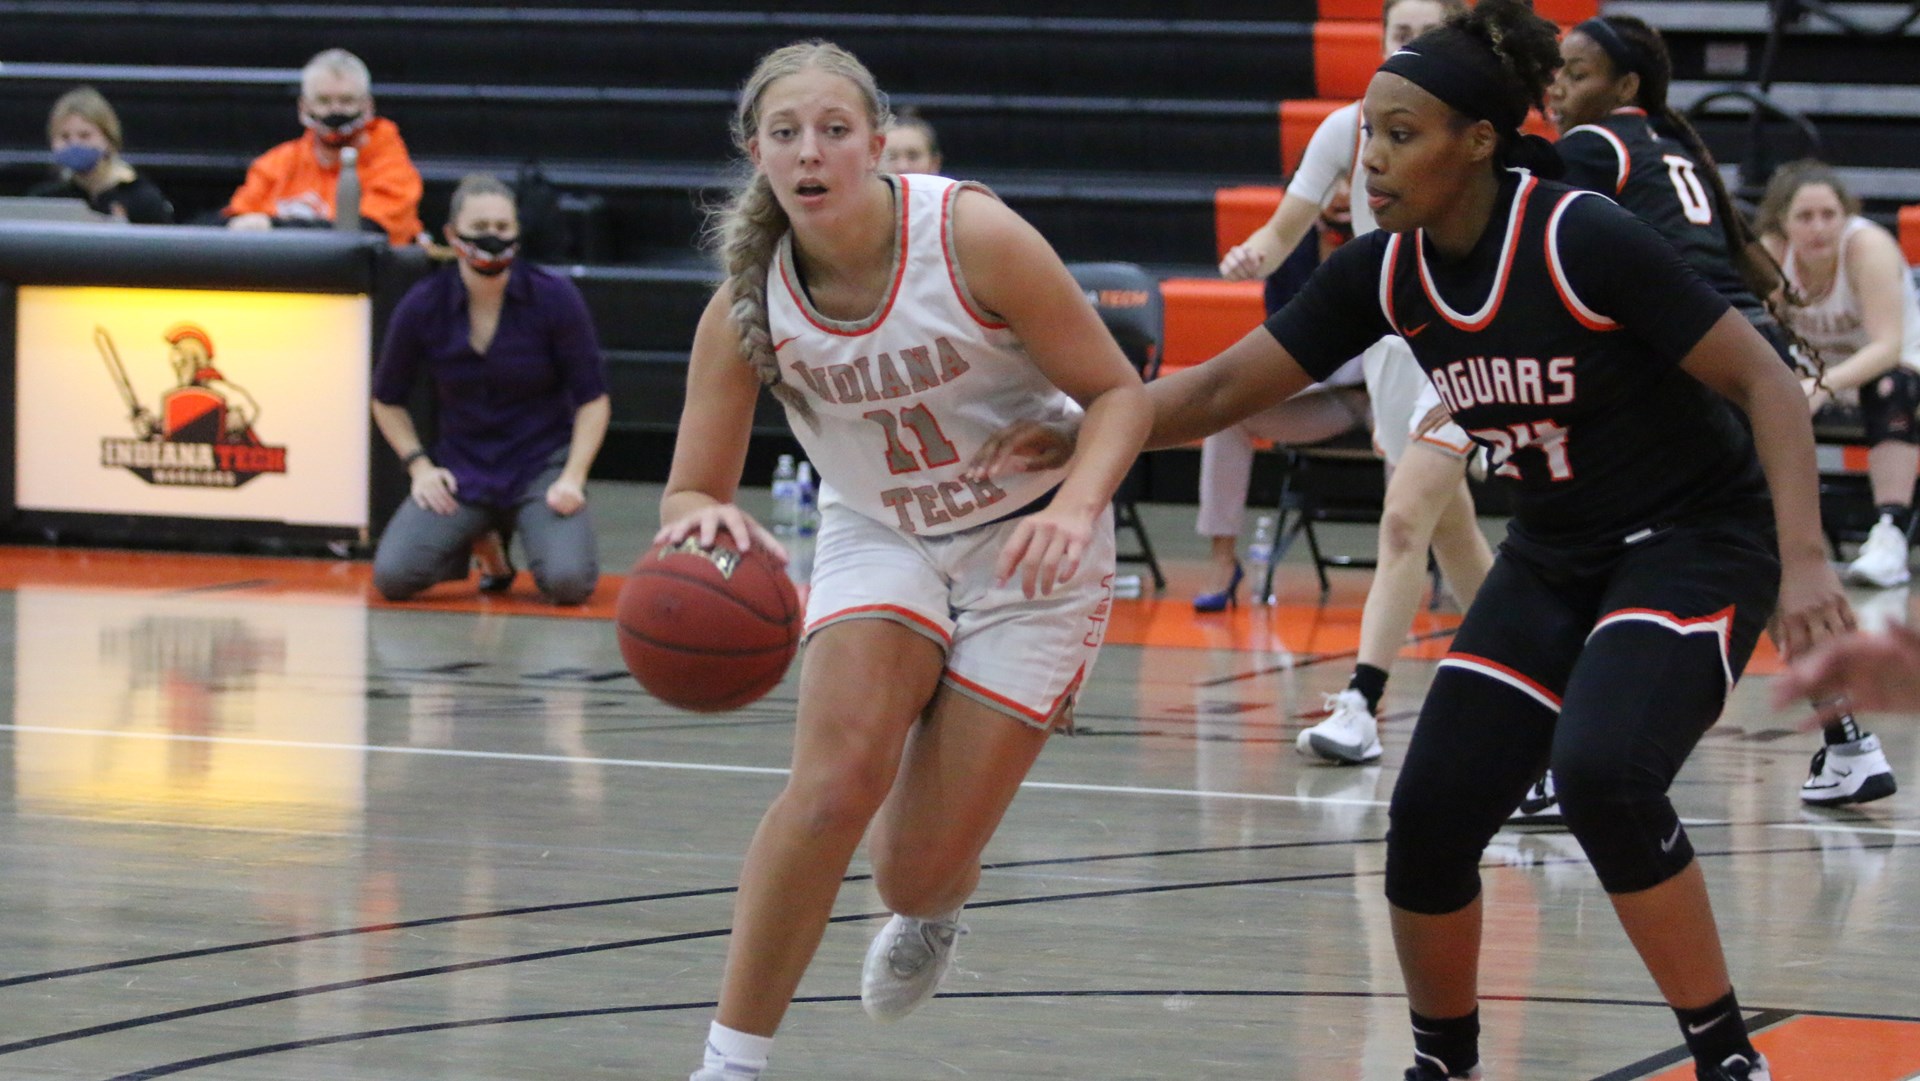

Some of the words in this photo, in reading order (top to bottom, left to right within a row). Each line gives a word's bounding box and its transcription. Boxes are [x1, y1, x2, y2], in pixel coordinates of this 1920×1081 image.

[1662, 153, 1712, 226] 0
[790, 336, 971, 404] INDIANA
[1432, 356, 1576, 414] AGUARS
[102, 439, 216, 470] INDIANA
[214, 444, 286, 473] TECH
[862, 402, 961, 475] 11
[1466, 418, 1575, 482] 24
[880, 473, 1008, 533] TECH
